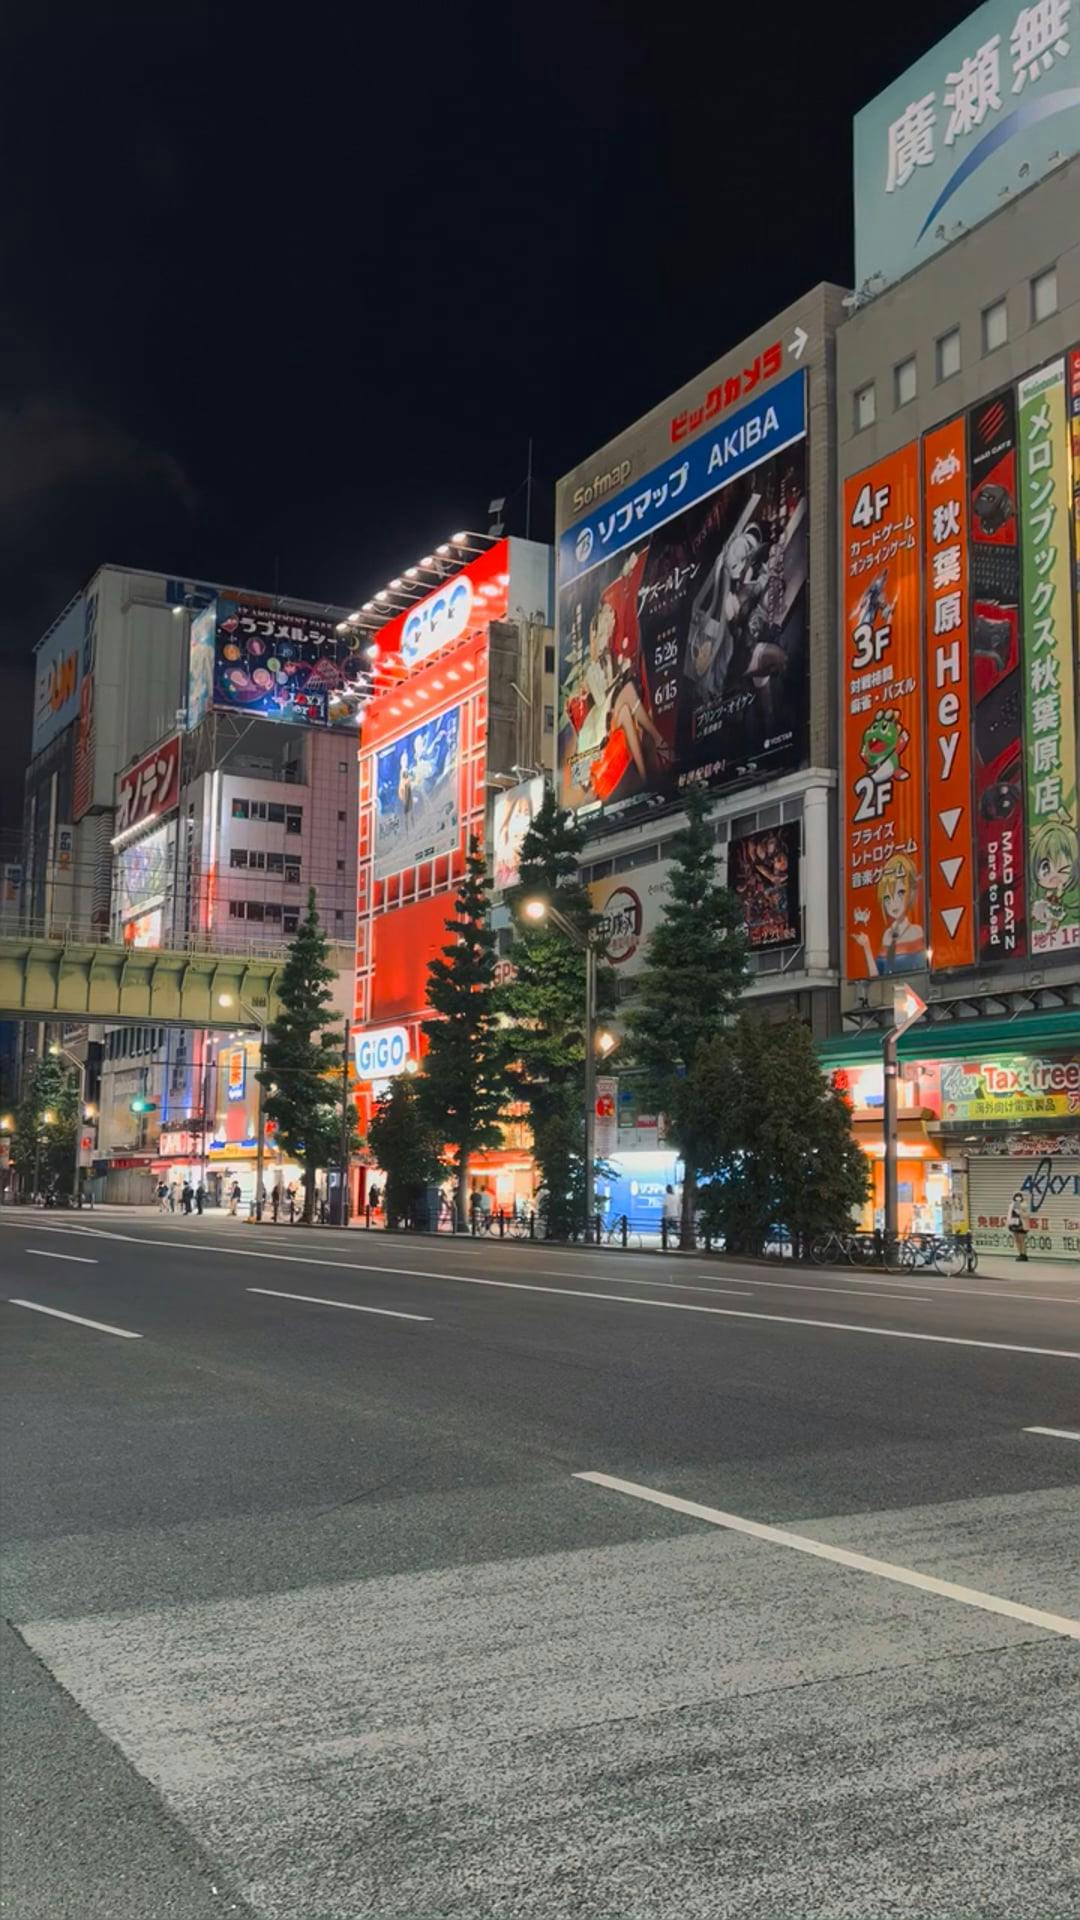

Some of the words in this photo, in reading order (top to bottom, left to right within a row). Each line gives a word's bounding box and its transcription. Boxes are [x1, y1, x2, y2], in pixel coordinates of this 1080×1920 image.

[670, 339, 783, 443] ビックカメラ
[573, 460, 632, 513] Sofmap
[598, 462, 690, 544] ソフマップ
[707, 405, 779, 474] AKIBA
[852, 485, 889, 527] 4F
[850, 514, 915, 558] カードゲーム
[850, 534, 916, 577] オンラインゲーム
[932, 499, 961, 634] 秋葉原
[240, 617, 338, 645] ラブメルシー
[1028, 403, 1060, 815] メロンブックス秋葉原店
[853, 624, 891, 669] 3F
[936, 641, 960, 780] Hey
[117, 752, 175, 829] オノデン
[853, 777, 892, 823] 2F
[852, 837, 918, 868] レトロゲーム
[988, 842, 999, 881] Dare
[1002, 831, 1014, 884] MAD
[851, 864, 906, 889] 音楽ゲーム
[989, 884, 999, 901] to
[989, 903, 1001, 945] Lead
[1004, 890, 1015, 950] CATZ
[359, 1034, 404, 1071] GiGO
